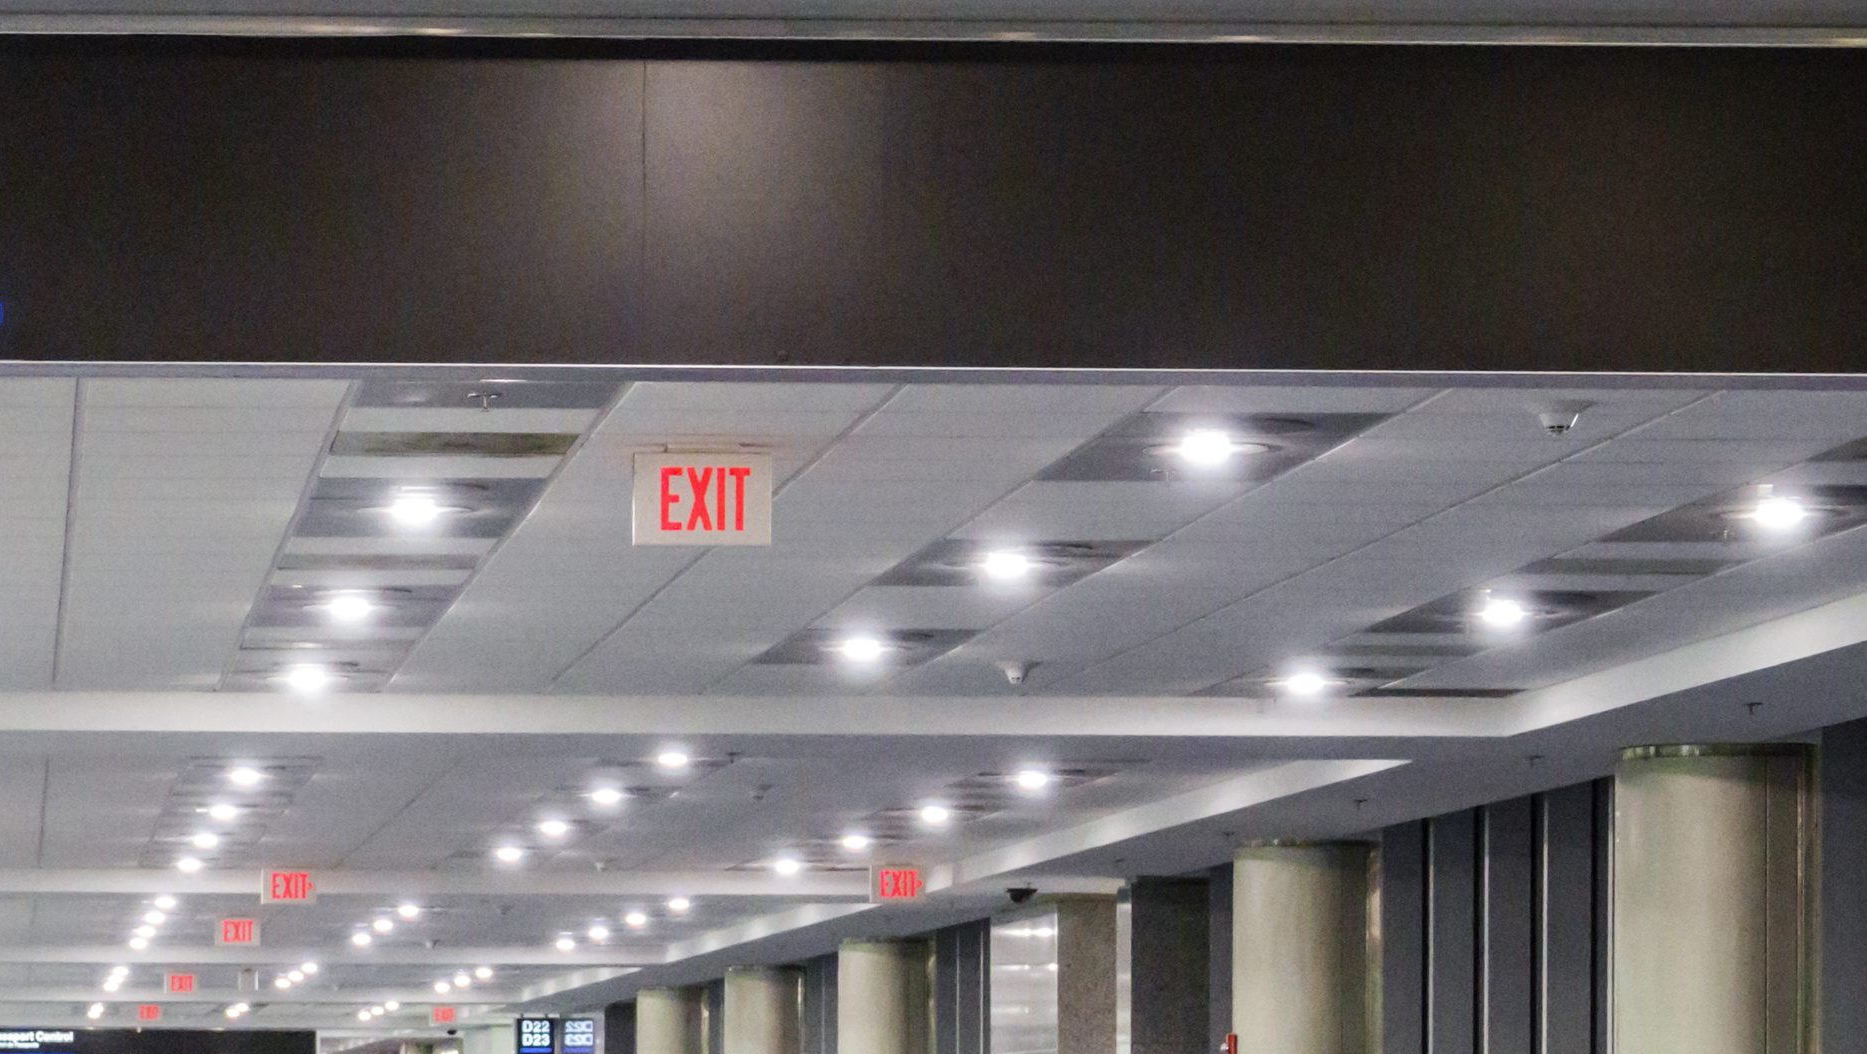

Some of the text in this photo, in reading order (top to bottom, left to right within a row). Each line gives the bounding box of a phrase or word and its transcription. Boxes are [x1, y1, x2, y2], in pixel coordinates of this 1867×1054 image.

[659, 466, 752, 532] EXIT
[271, 871, 310, 900] EXIT
[879, 869, 919, 897] EXIT
[222, 918, 253, 943] EXIT
[169, 974, 194, 993] EXIT
[35, 1030, 74, 1043] Control
[521, 1019, 551, 1033] D22
[521, 1033, 551, 1047] D23
